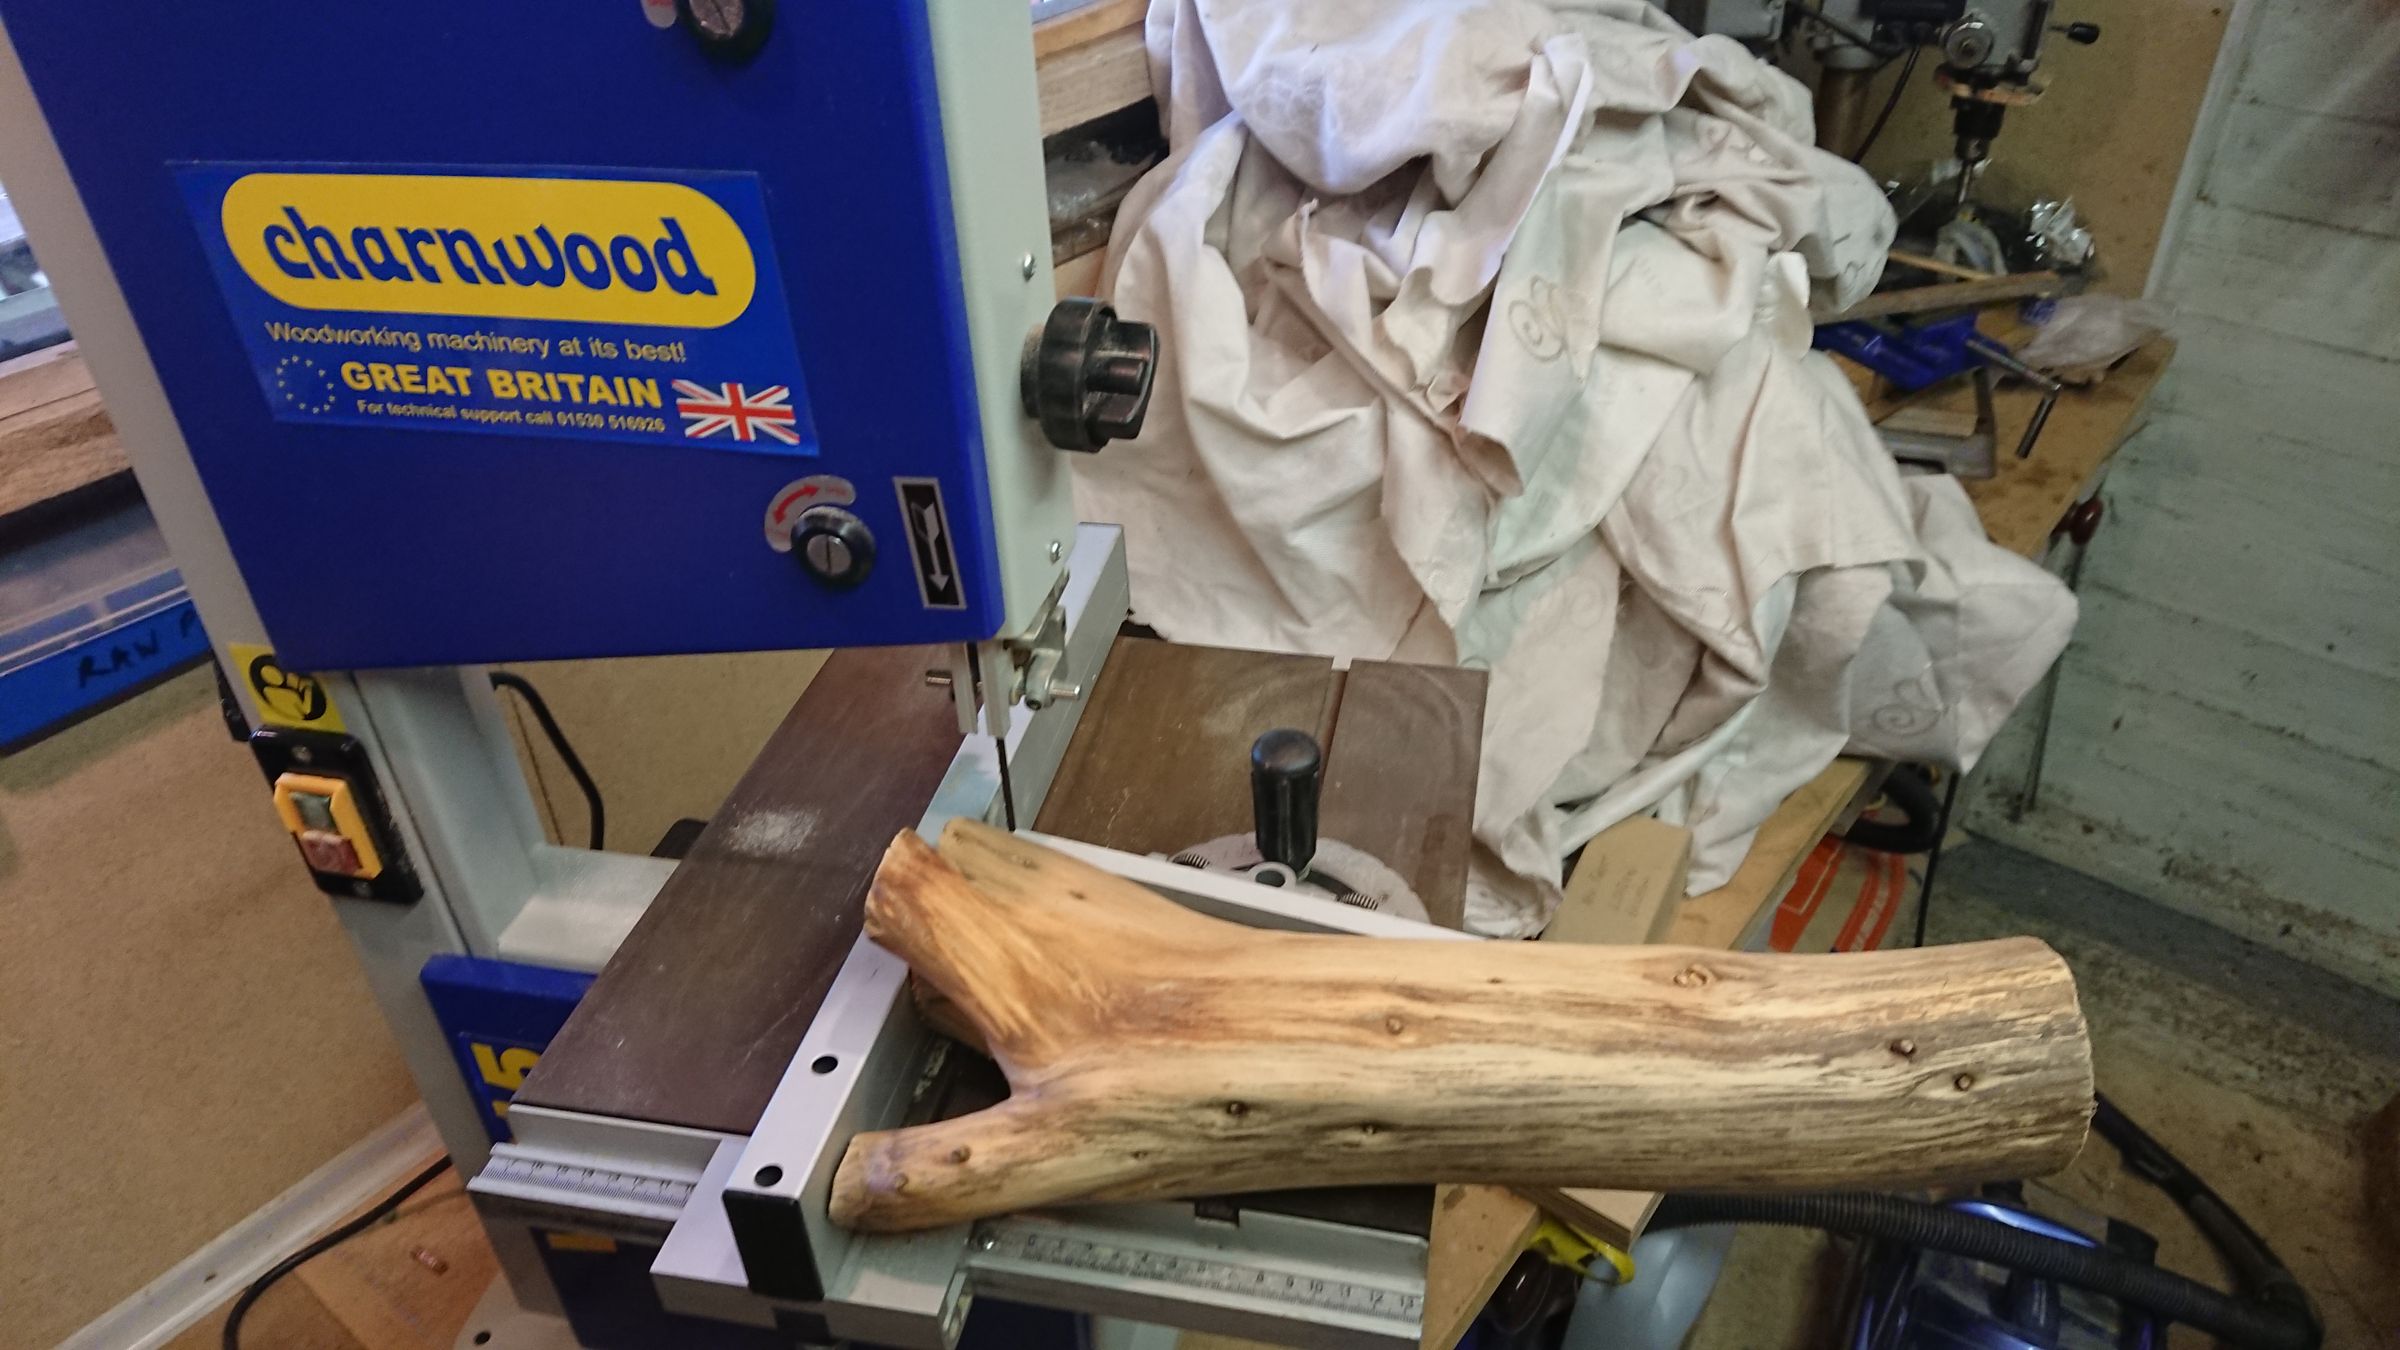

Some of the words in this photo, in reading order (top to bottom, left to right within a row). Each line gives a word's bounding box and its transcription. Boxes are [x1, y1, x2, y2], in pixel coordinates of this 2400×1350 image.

[263, 206, 718, 296] charnwood
[264, 321, 422, 352] Woodworking
[427, 331, 550, 359] machinery
[558, 337, 584, 358] at
[588, 337, 619, 359] its
[623, 338, 687, 363] best!
[340, 361, 473, 397] GREAT
[486, 368, 663, 409] BRITAIN
[357, 400, 384, 414] For
[386, 402, 457, 419] technical
[460, 408, 522, 425] support
[525, 411, 553, 426] call
[1310, 1280, 1324, 1293] 10
[1368, 1287, 1385, 1303] 12
